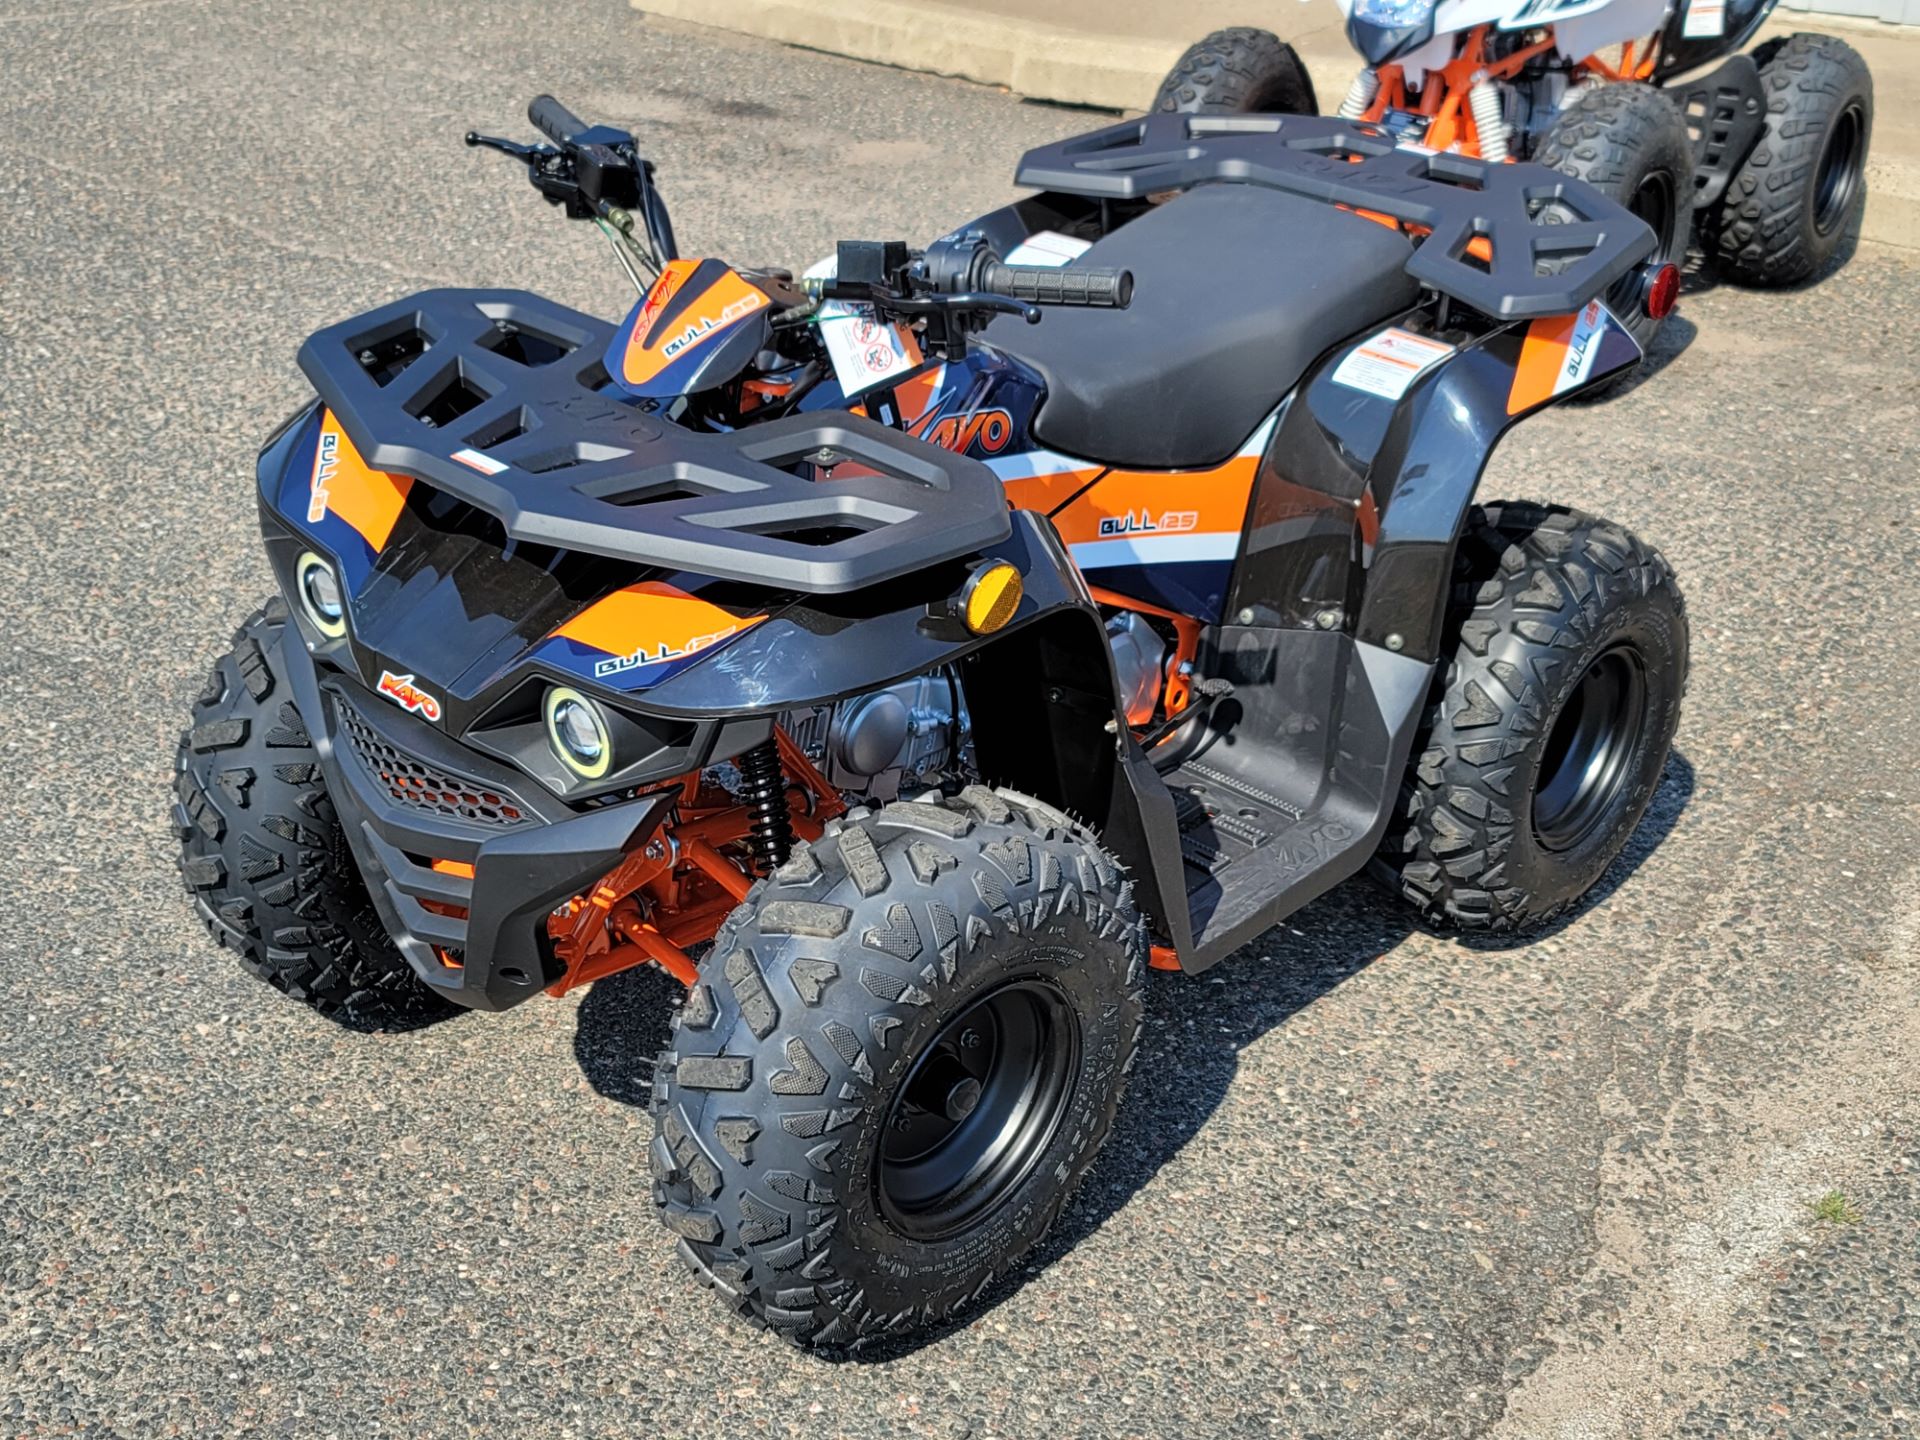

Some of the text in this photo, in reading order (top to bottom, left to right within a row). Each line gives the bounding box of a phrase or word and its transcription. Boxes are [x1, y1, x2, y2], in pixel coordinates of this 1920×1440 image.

[663, 316, 724, 358] BULL
[1566, 331, 1592, 378] BULL
[315, 434, 338, 490] BULL
[1099, 511, 1198, 535] BULL 125
[597, 645, 683, 675] BULL
[379, 671, 440, 720] KAYO
